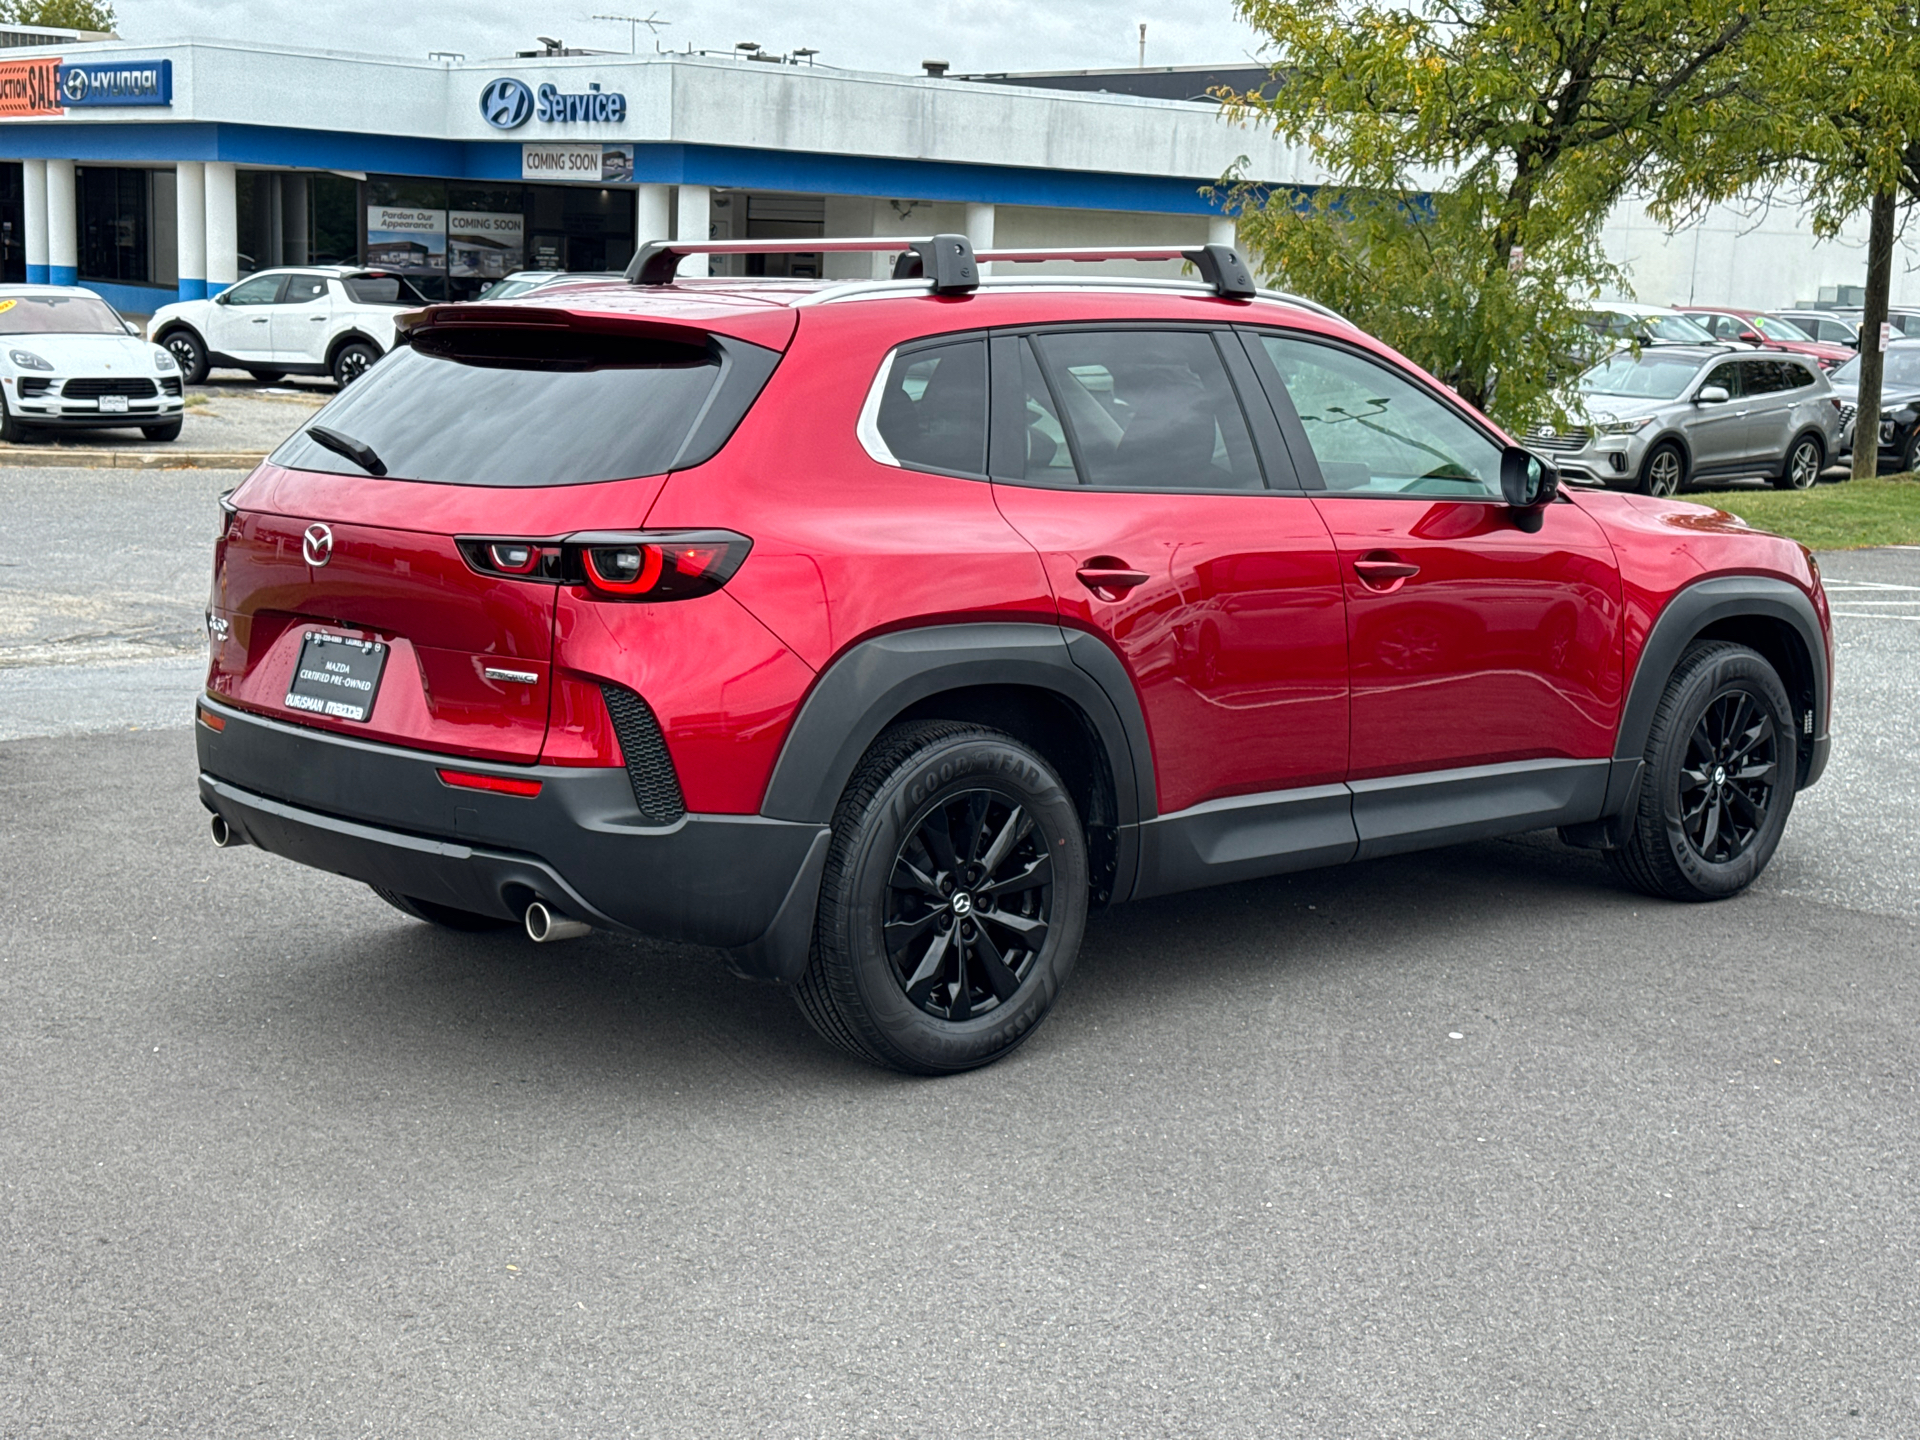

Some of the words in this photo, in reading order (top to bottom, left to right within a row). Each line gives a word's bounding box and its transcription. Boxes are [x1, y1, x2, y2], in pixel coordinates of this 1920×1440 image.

[28, 64, 61, 110] SALE
[91, 70, 158, 96] HYUNDAI
[537, 83, 627, 122] Service
[526, 152, 565, 169] COMING
[568, 153, 598, 171] SOON
[380, 219, 434, 230] Appearance
[381, 210, 414, 221] Pardon
[417, 212, 433, 221] Our
[452, 217, 491, 230] COMING
[493, 219, 521, 231] SOON
[325, 660, 350, 674] MAZDA
[300, 669, 330, 683] CERTIFIED
[330, 675, 371, 691] PRE-OWNED
[284, 693, 325, 713] OURISMAN
